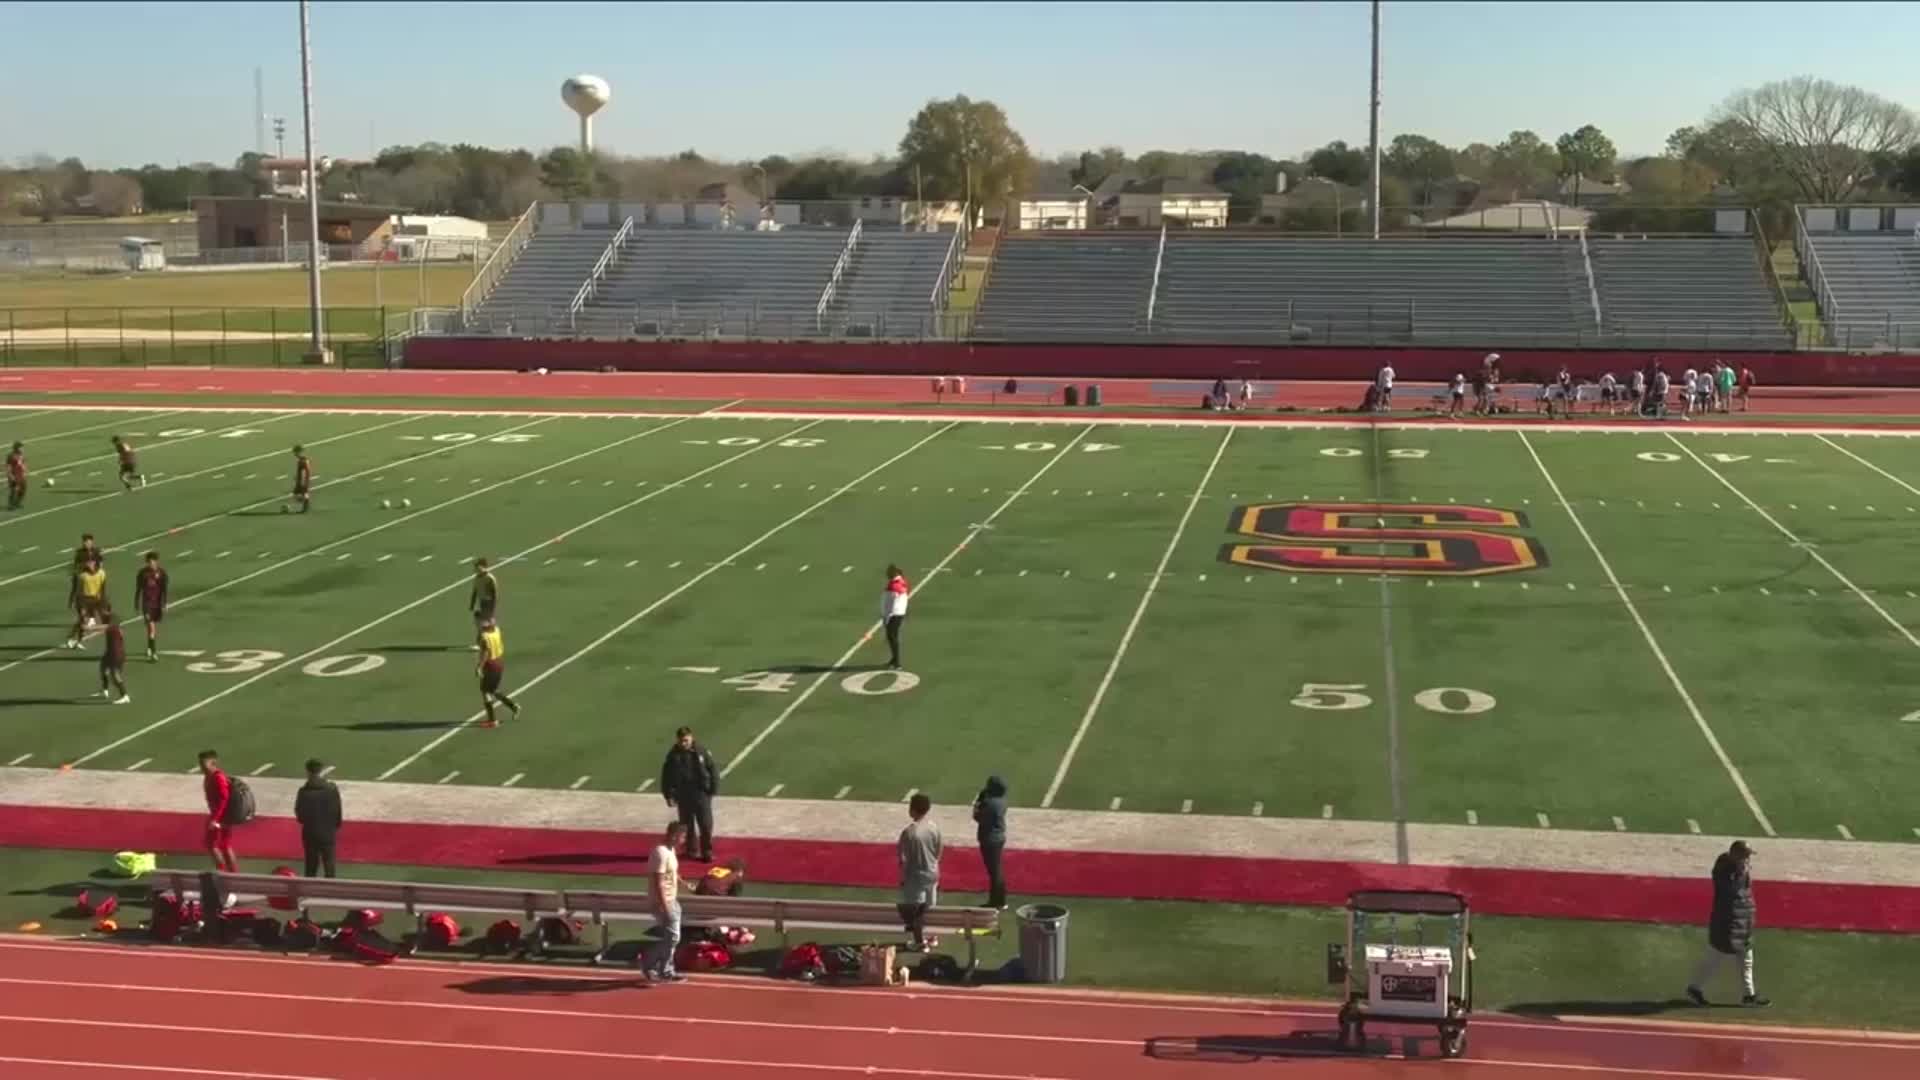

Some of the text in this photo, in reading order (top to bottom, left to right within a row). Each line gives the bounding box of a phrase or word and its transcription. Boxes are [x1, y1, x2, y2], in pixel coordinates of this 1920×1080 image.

[1217, 503, 1549, 575] S
[185, 649, 386, 676] 30
[722, 670, 919, 694] 40
[1290, 683, 1495, 713] 50
